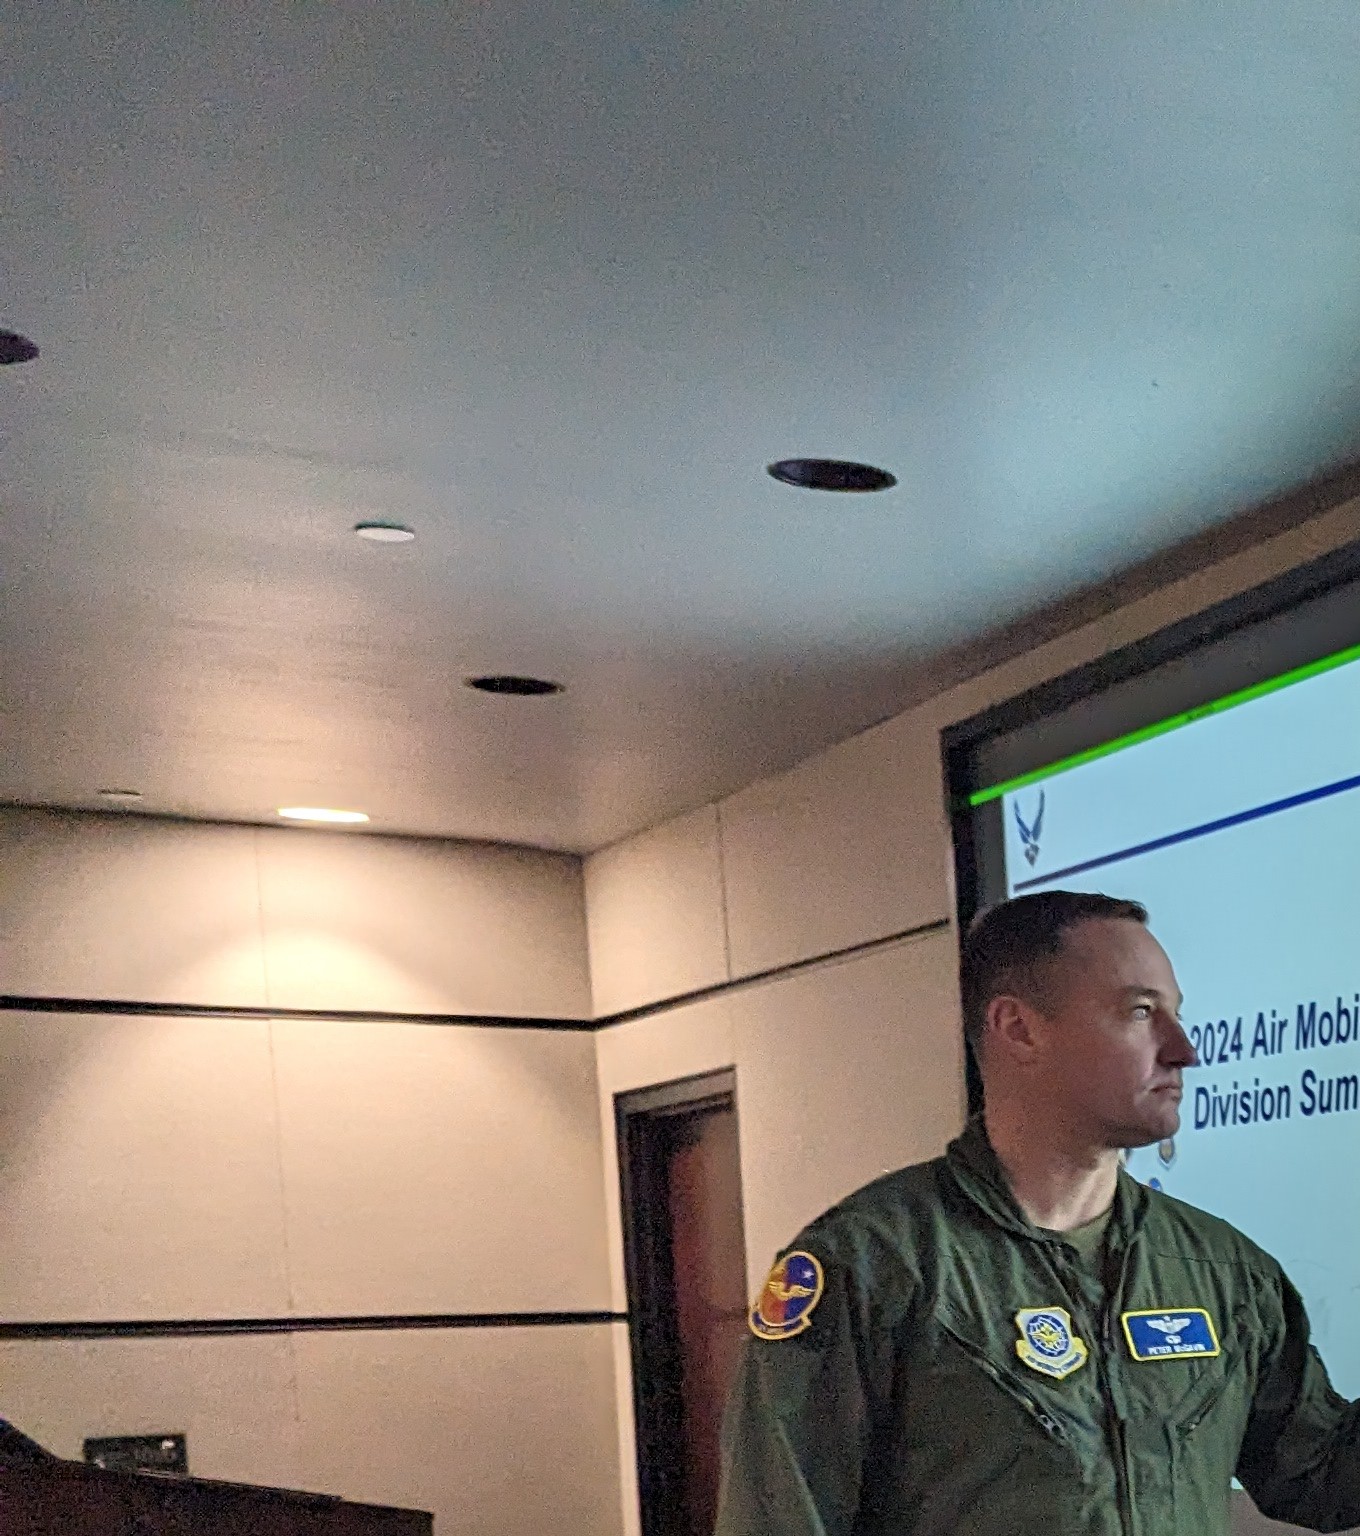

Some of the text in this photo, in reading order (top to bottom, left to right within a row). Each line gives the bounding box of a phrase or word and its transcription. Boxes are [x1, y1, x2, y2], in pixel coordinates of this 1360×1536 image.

[1190, 1016, 1244, 1068] 2024
[1250, 1009, 1289, 1059] Air
[1194, 1077, 1291, 1131] Division
